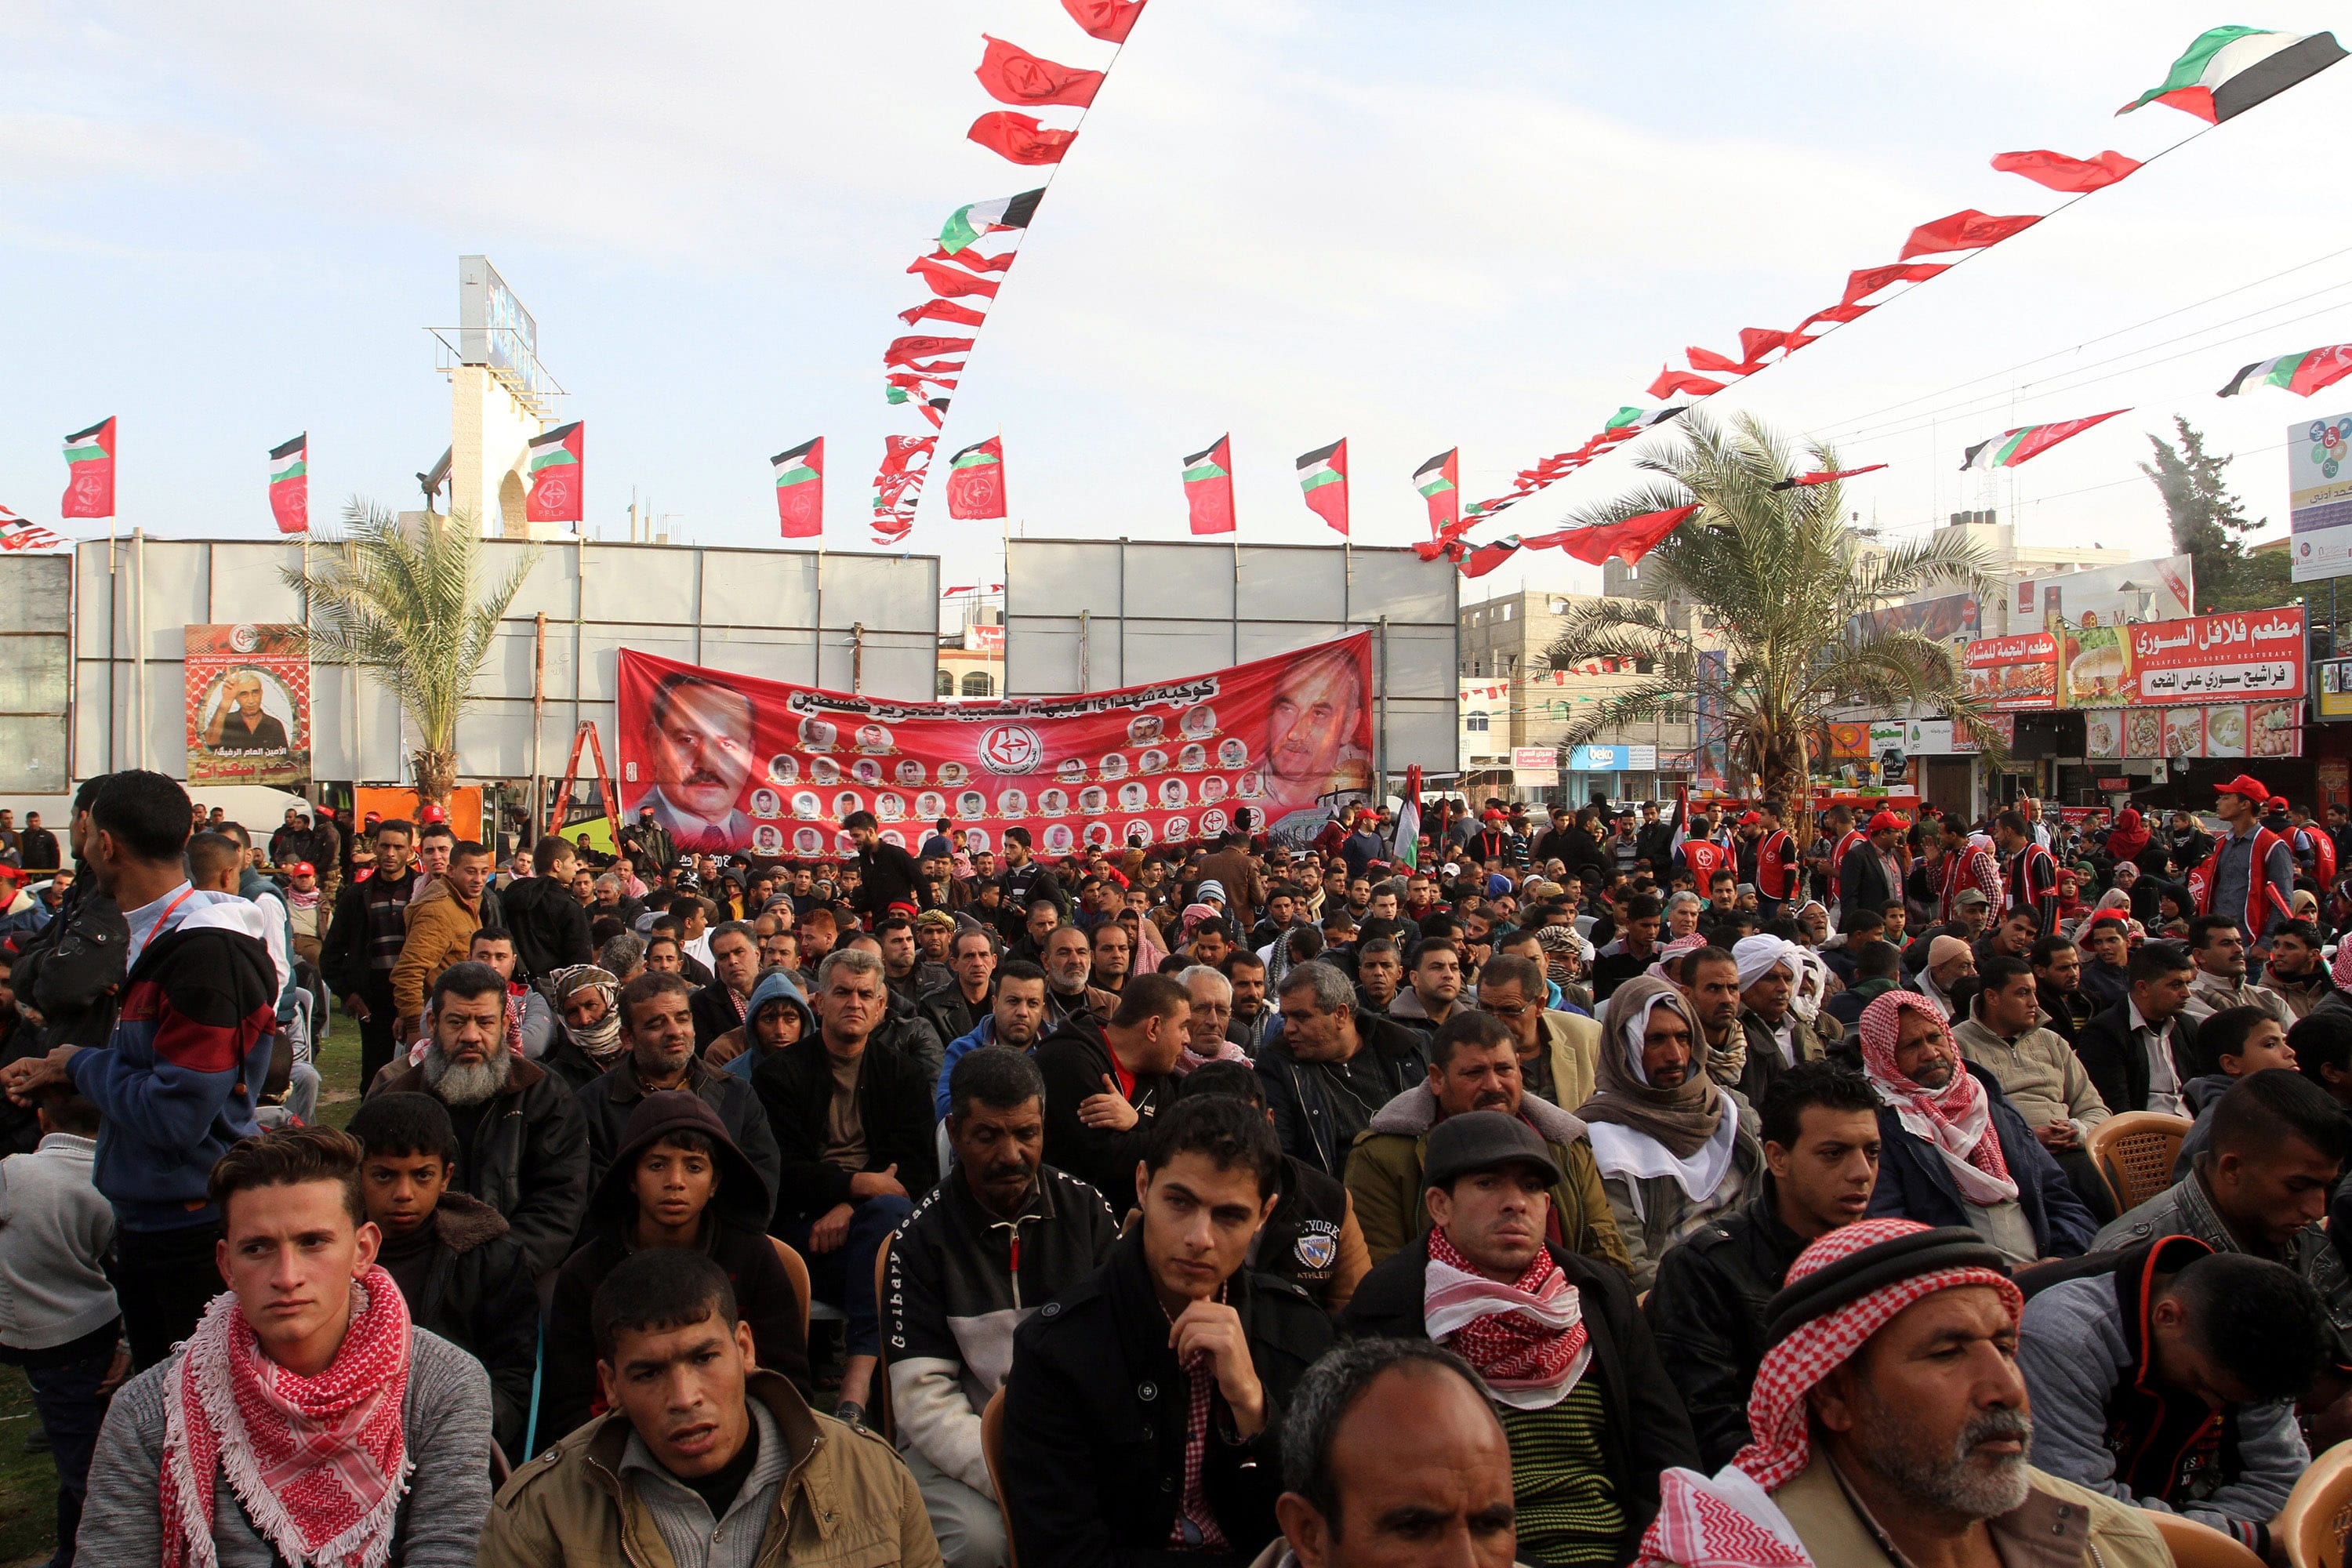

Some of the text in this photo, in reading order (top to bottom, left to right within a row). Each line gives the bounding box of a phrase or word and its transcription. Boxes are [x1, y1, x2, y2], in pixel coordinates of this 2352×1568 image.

[2135, 622, 2195, 659] السوري
[2199, 617, 2246, 651] فلافل
[2251, 615, 2301, 648] مطعم
[1997, 640, 2026, 662] النجمة
[2027, 637, 2053, 659] مطعم
[2145, 658, 2182, 666] FALAFEL
[2238, 650, 2294, 659] RESTURANT
[2151, 664, 2285, 692] فراشيح سوري على الفحم
[1099, 691, 1156, 710] شهداء
[1155, 677, 1215, 705] كوكبة
[874, 705, 946, 719] لتحرير
[244, 746, 263, 757] العام
[265, 746, 286, 756] الأمين
[1589, 747, 1614, 760] beko
[197, 751, 302, 779] أحمد سعدات
[1308, 1219, 1341, 1240] YORK
[1305, 1246, 1325, 1260] NY
